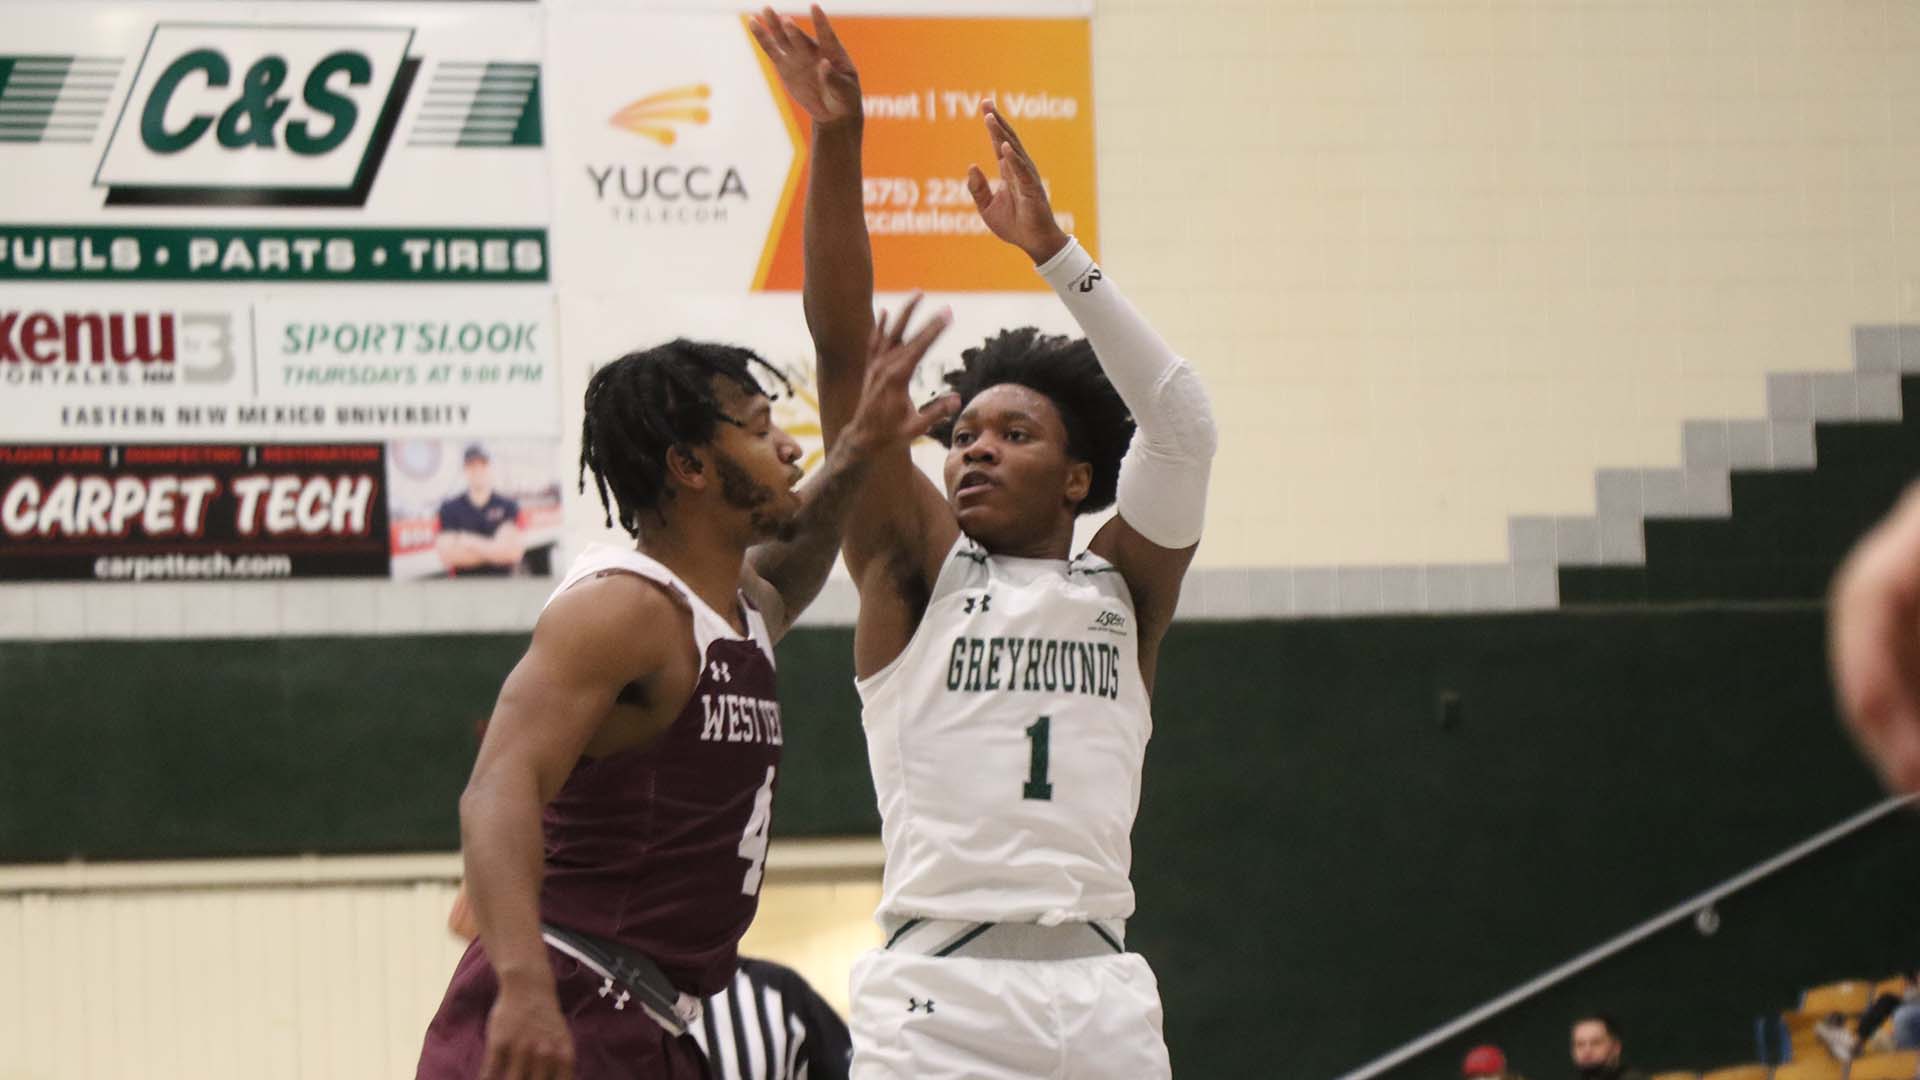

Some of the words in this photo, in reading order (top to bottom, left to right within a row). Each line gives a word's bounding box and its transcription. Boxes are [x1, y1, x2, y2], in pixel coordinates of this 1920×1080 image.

[141, 48, 374, 155] C&S
[943, 92, 981, 118] TV
[1004, 93, 1078, 118] Voice
[586, 164, 749, 202] YUCCA
[611, 206, 728, 224] TELECOM
[189, 238, 355, 272] PARTS
[403, 239, 543, 272] TIRES
[282, 321, 539, 354] SPORTSLOOK
[0, 368, 129, 384] ORTALES
[284, 365, 416, 385] THURSDAYS
[427, 364, 455, 384] AT
[507, 364, 543, 384] PM
[61, 405, 165, 425] EASTERN
[177, 405, 227, 425] NEW
[238, 405, 325, 425] MEXICO
[336, 405, 470, 425] UNIVERSITY
[1, 475, 217, 535] CARPET
[233, 475, 373, 534] TECH
[95, 553, 292, 581] carpettech.com
[947, 637, 1120, 700] GREYHOUNDS
[700, 694, 761, 743] WEST
[1023, 716, 1053, 801] 1
[738, 765, 775, 896] 4
